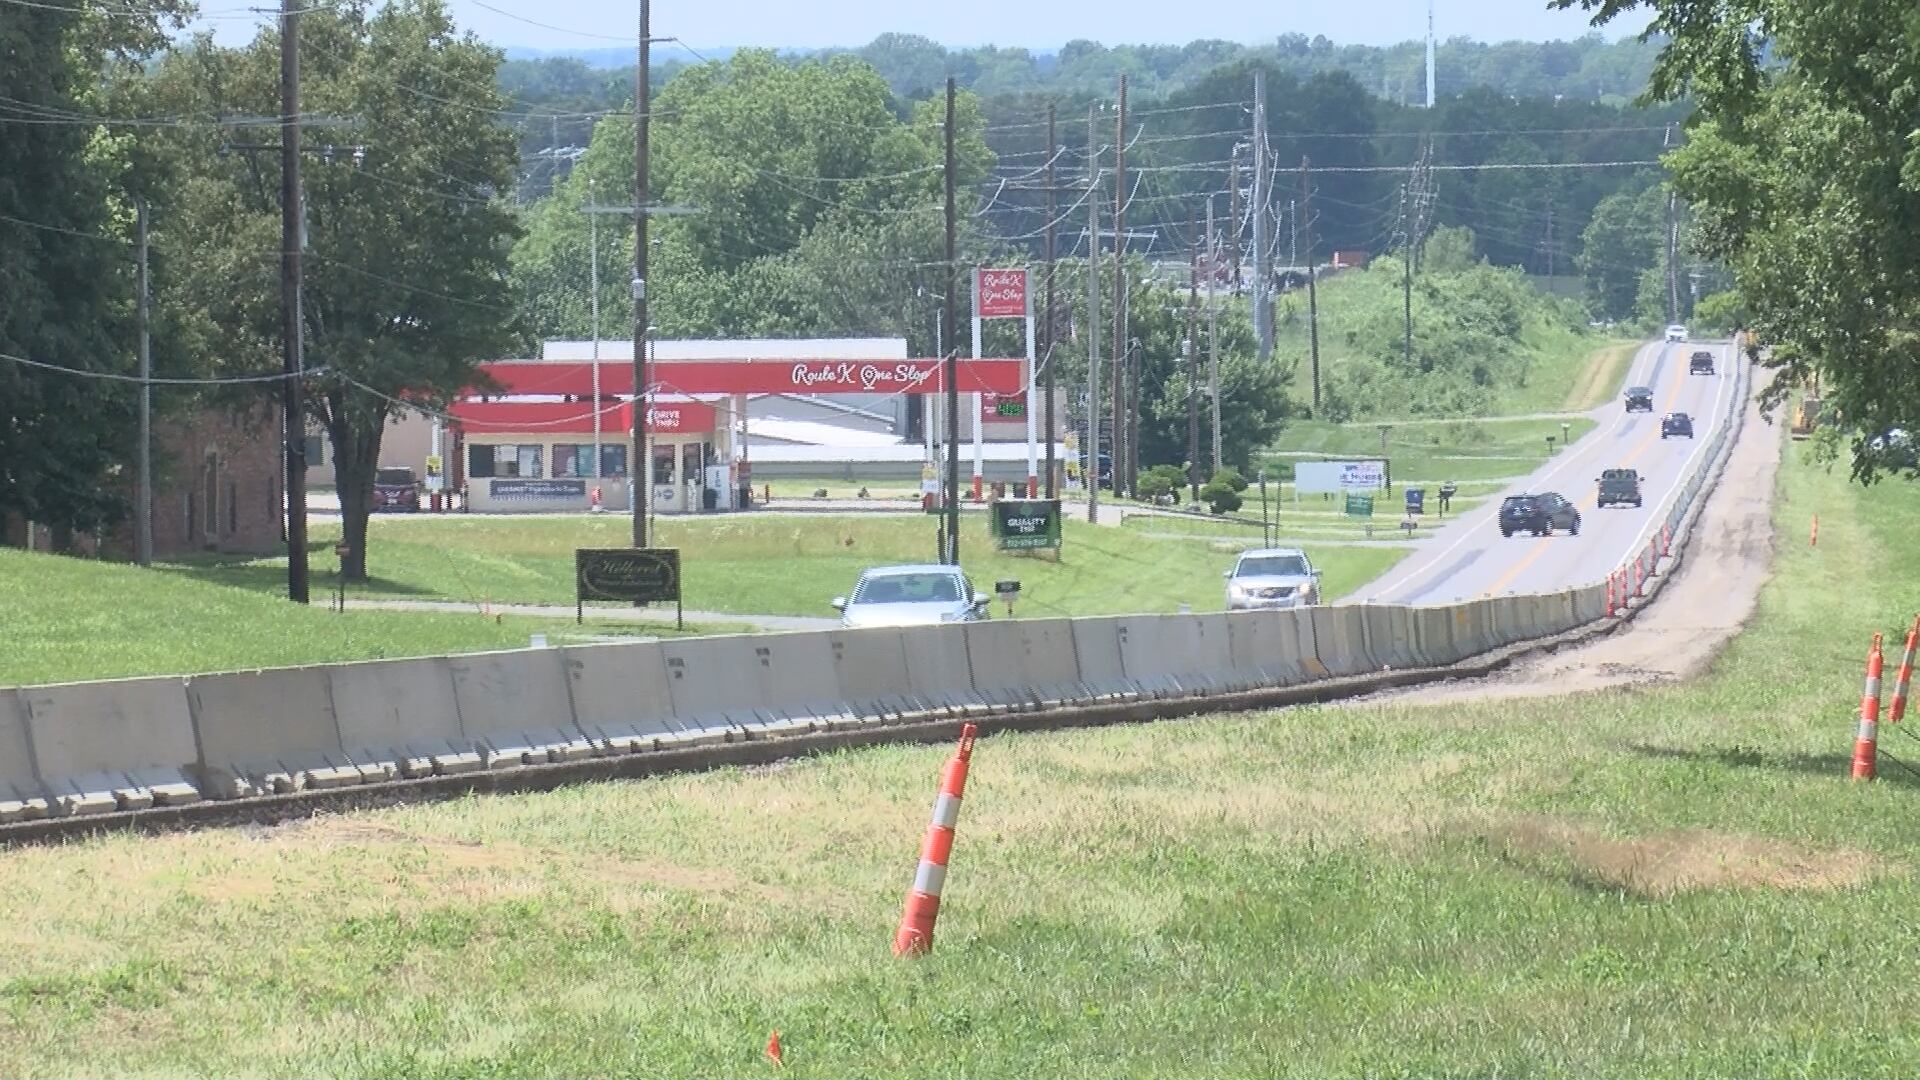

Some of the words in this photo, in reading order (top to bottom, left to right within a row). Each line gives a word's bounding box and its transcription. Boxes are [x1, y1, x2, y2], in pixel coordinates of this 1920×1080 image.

[984, 274, 1008, 286] Route
[1002, 288, 1023, 301] Stop
[792, 364, 836, 385] Route
[837, 363, 856, 384] K
[861, 365, 892, 389] One
[894, 365, 931, 386] Stop
[654, 410, 681, 419] DRIVE
[1007, 518, 1047, 527] QUALITY
